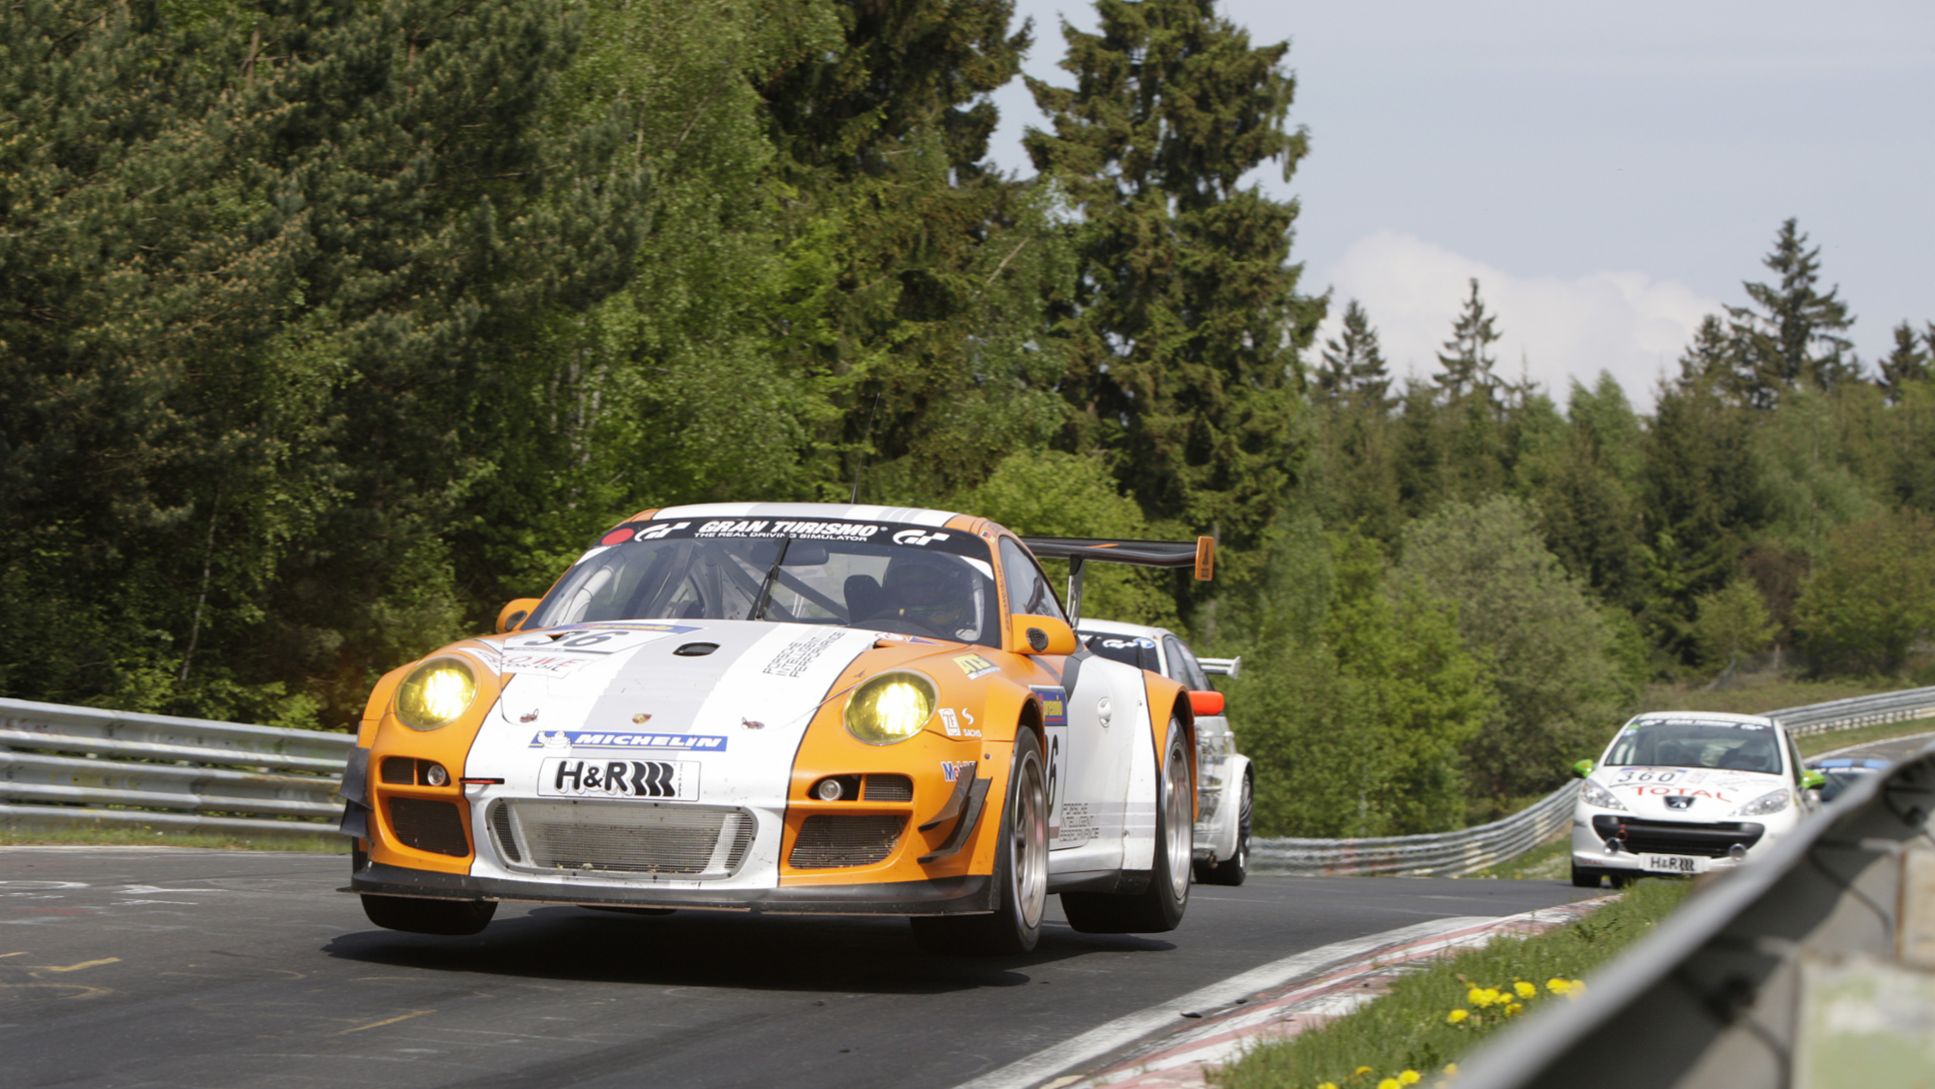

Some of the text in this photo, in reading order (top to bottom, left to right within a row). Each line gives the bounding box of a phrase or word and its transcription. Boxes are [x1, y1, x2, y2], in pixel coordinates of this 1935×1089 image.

[698, 520, 879, 538] GRAN TURISMO
[799, 533, 868, 543] SIMULATOR
[523, 630, 630, 648] 36
[575, 733, 723, 748] MICHELIN
[555, 760, 628, 792] H&R
[1617, 771, 1676, 783] 360
[1630, 786, 1733, 803] TOTAL
